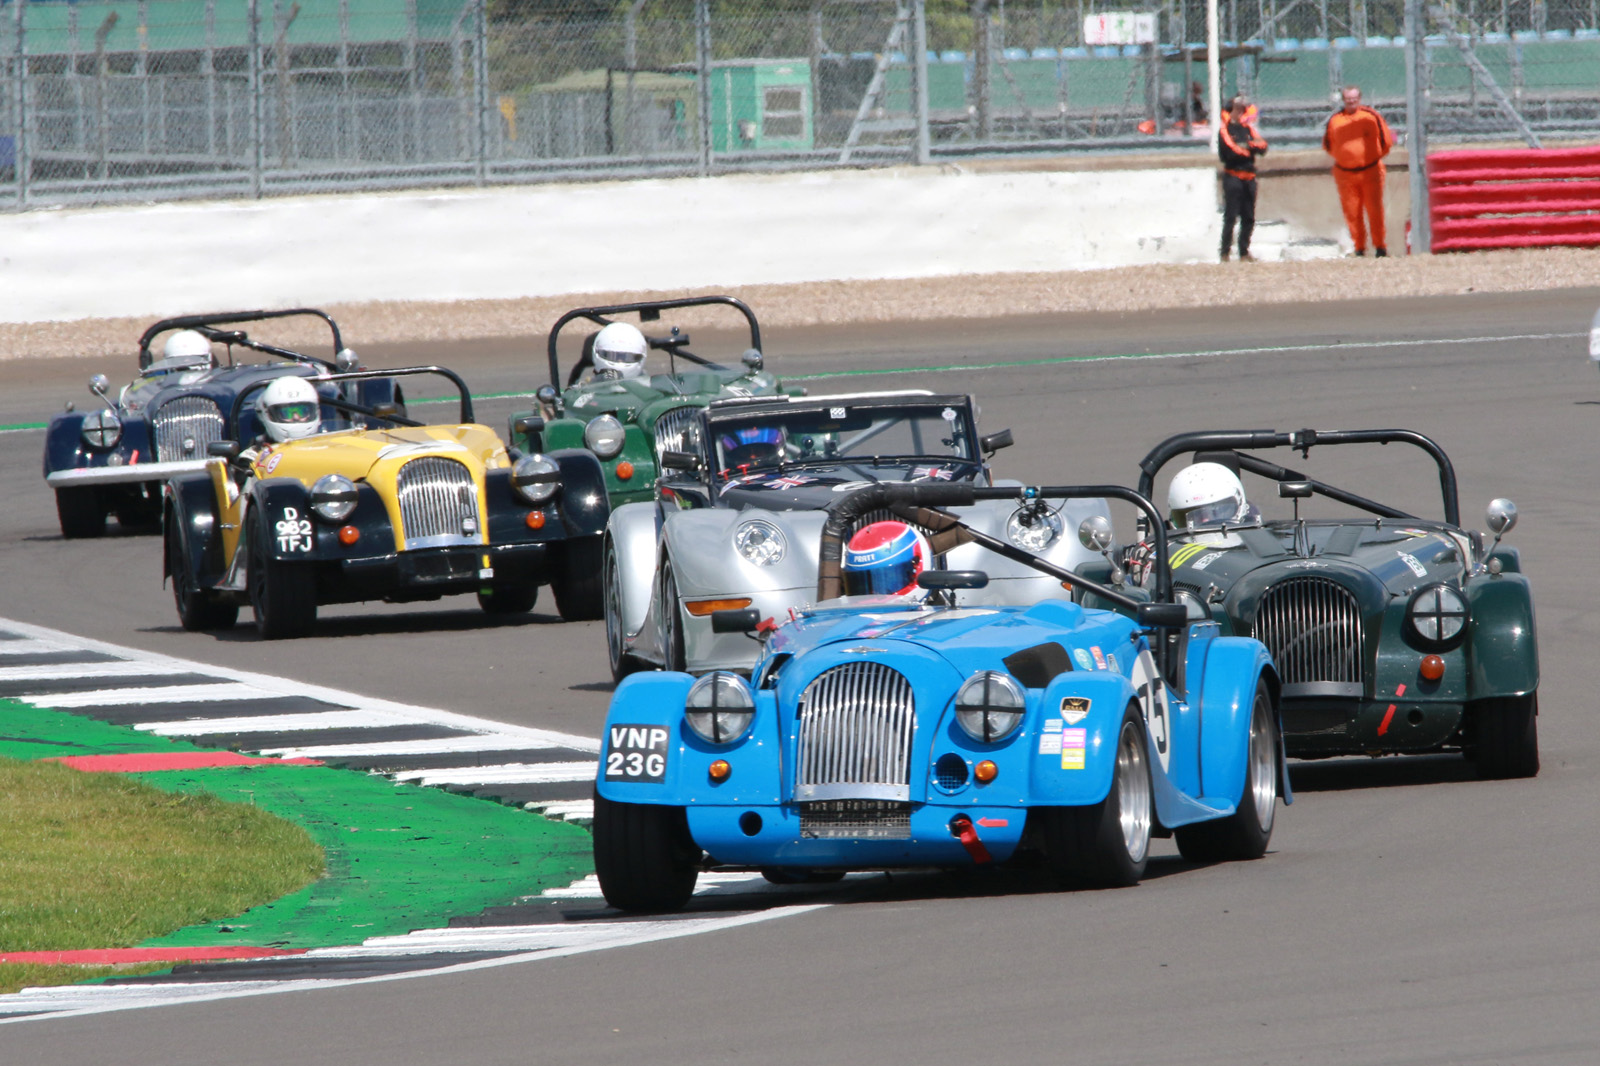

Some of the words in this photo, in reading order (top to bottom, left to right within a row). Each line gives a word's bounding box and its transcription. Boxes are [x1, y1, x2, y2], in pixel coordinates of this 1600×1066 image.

[284, 507, 298, 520] D
[276, 520, 312, 535] 982
[277, 535, 312, 552] TFJ
[854, 554, 875, 562] PRATT
[611, 728, 667, 749] VNP
[606, 752, 665, 777] 23G
